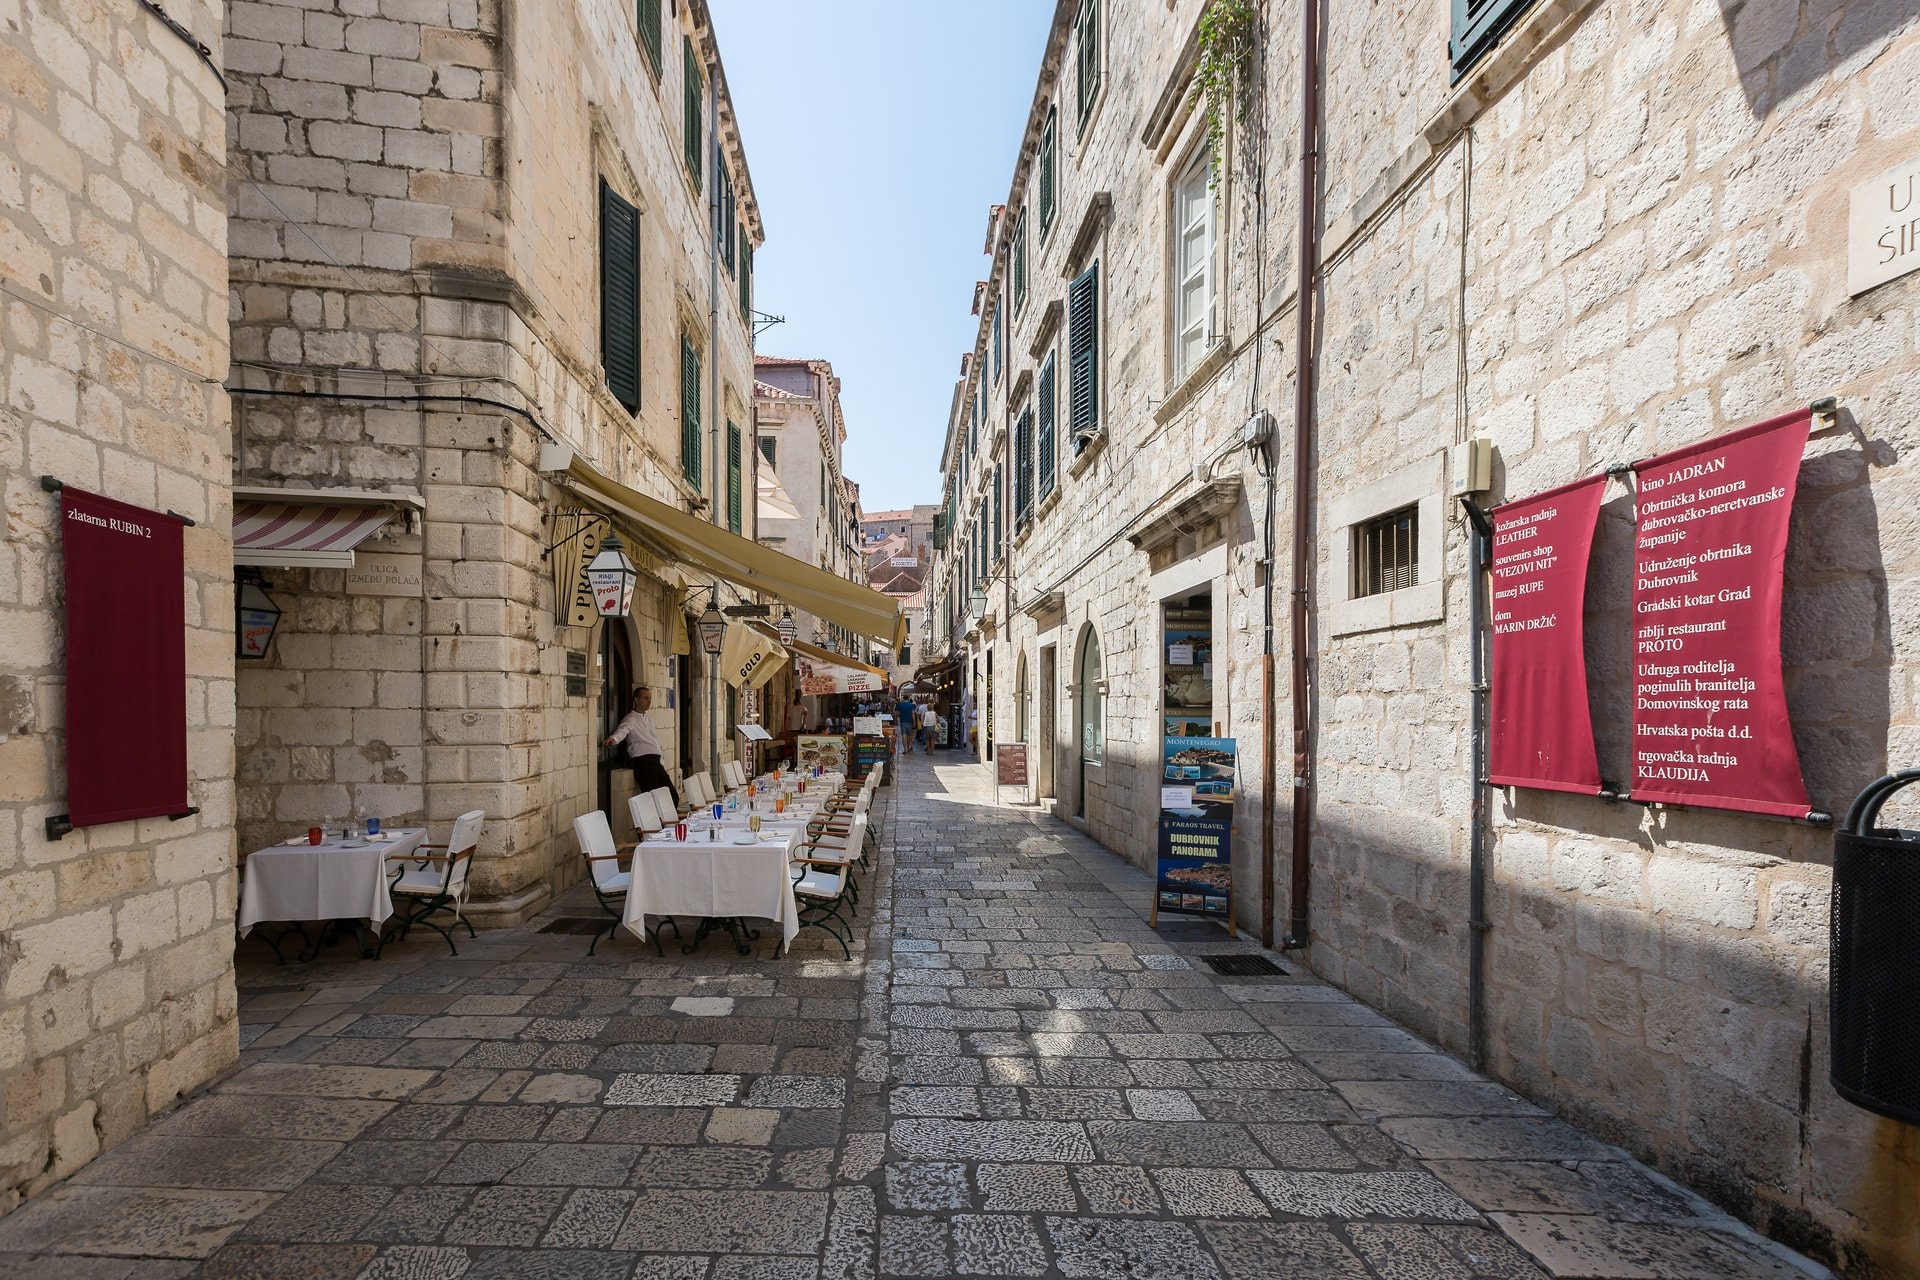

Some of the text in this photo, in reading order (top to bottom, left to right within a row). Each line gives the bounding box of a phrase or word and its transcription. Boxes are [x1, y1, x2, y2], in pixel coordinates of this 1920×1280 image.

[1889, 174, 1919, 213] U
[1641, 456, 1726, 493] kino JADRAN
[1641, 479, 1746, 516] Obrtnička komora
[1641, 486, 1786, 532] dubrovačko-neretvanske
[68, 508, 152, 538] zlatarna RUBIN 2
[1495, 507, 1557, 533] kožarska radnja
[1495, 526, 1538, 546] LEATHER
[1639, 530, 1687, 549] županije
[630, 542, 654, 570] PROTO
[1495, 545, 1553, 566] souvenirs shop
[1639, 543, 1752, 574] Udruženje obrtnika
[370, 564, 399, 574] ULICA
[576, 533, 596, 608] PROTO
[1495, 556, 1557, 578] "VEZOVI NIT"
[385, 574, 420, 585] POLAČA
[1638, 569, 1699, 591] Dubrovnik
[597, 585, 620, 596] Proto
[1495, 580, 1544, 599] muzej RUPE
[1637, 585, 1751, 614] Gradski kotar Grad
[1495, 611, 1511, 621] dom
[1495, 613, 1557, 635] MARIN DRŽIĆ
[244, 627, 272, 637] Proto
[1638, 619, 1727, 640] riblji restaurant
[1638, 638, 1684, 653] PROTO
[740, 652, 761, 678] GOLD
[1638, 660, 1735, 678] Udruga roditelja
[848, 683, 871, 692] PIZZE
[1637, 677, 1756, 695] poginulih branitelja
[1637, 696, 1749, 712] Domovinskog rata
[1636, 723, 1753, 740] Hrvatska pošta d.d.
[1166, 738, 1221, 746] MONTENEGRO
[1638, 750, 1738, 768] trgovačka radnja
[1638, 765, 1710, 782] KLAUDIJA
[1199, 822, 1225, 830] TRAVEL
[1170, 833, 1220, 846] DUBROVNIK
[1171, 845, 1218, 858] PANORAMA
